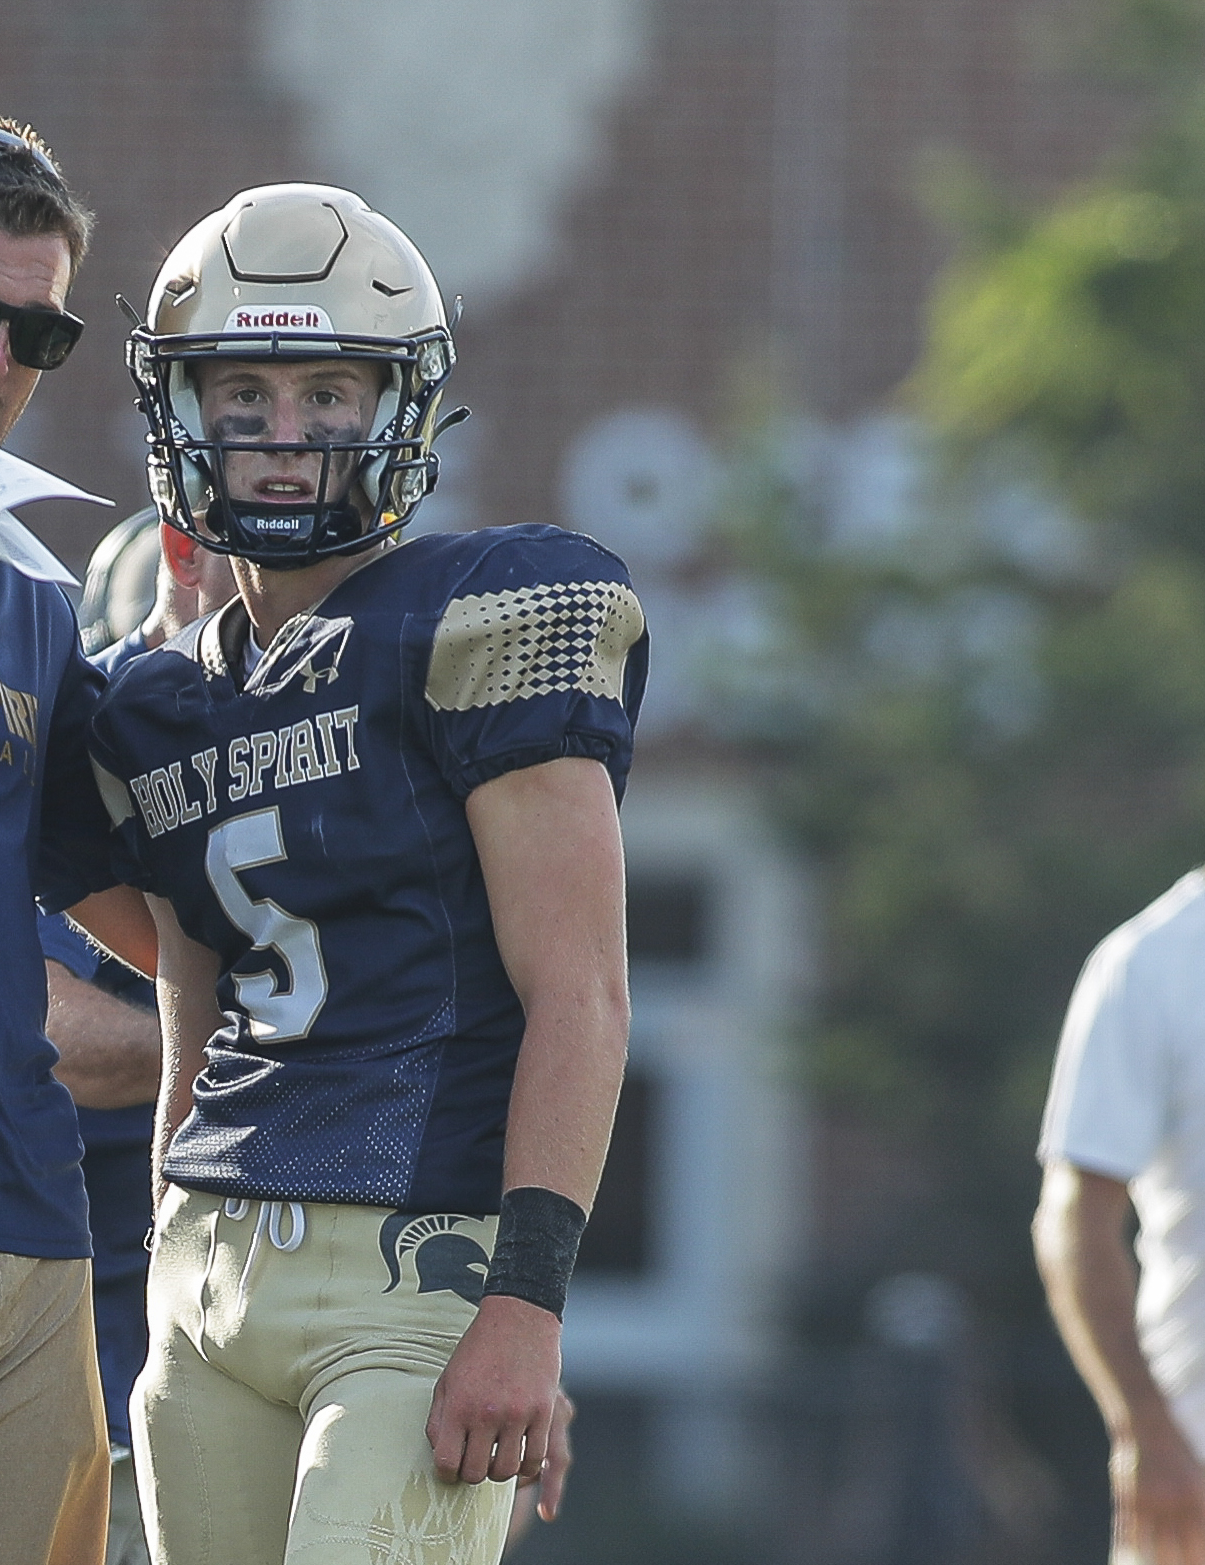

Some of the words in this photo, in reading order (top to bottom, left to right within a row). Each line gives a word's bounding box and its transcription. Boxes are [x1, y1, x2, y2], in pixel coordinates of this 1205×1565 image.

[236, 311, 319, 328] Riddell
[256, 518, 299, 531] Riddell
[130, 747, 219, 839] HOLY
[228, 704, 361, 802] SPIRIT
[204, 804, 329, 1045] 5
